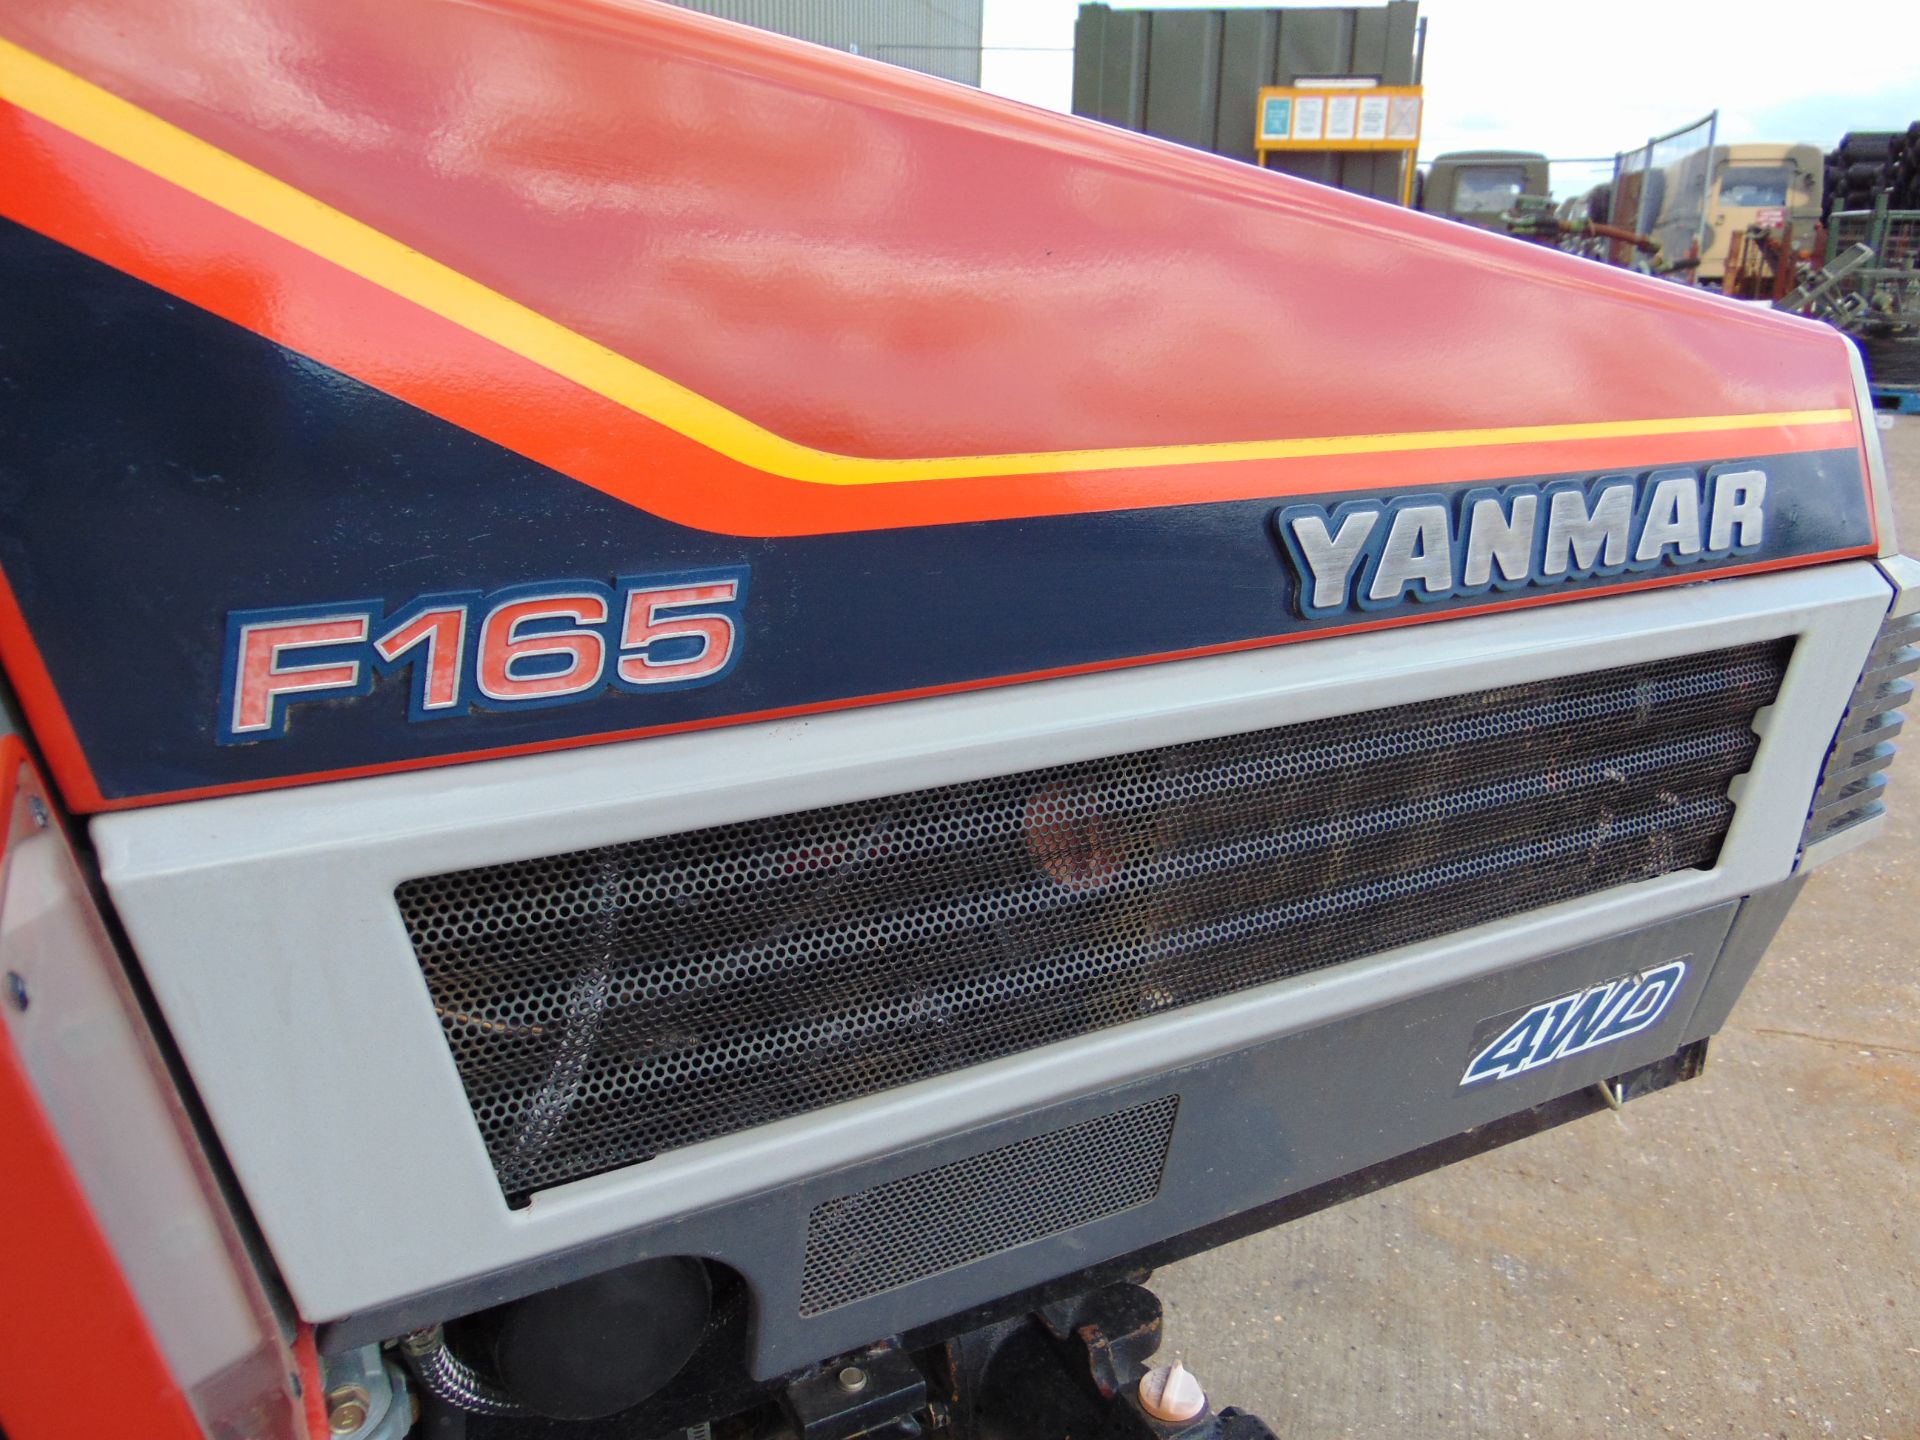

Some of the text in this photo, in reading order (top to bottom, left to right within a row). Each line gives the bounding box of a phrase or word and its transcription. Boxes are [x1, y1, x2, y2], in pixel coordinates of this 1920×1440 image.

[1291, 469, 1767, 609] YANMAR
[231, 579, 739, 735] F165
[1459, 961, 1686, 1086] 4WD
